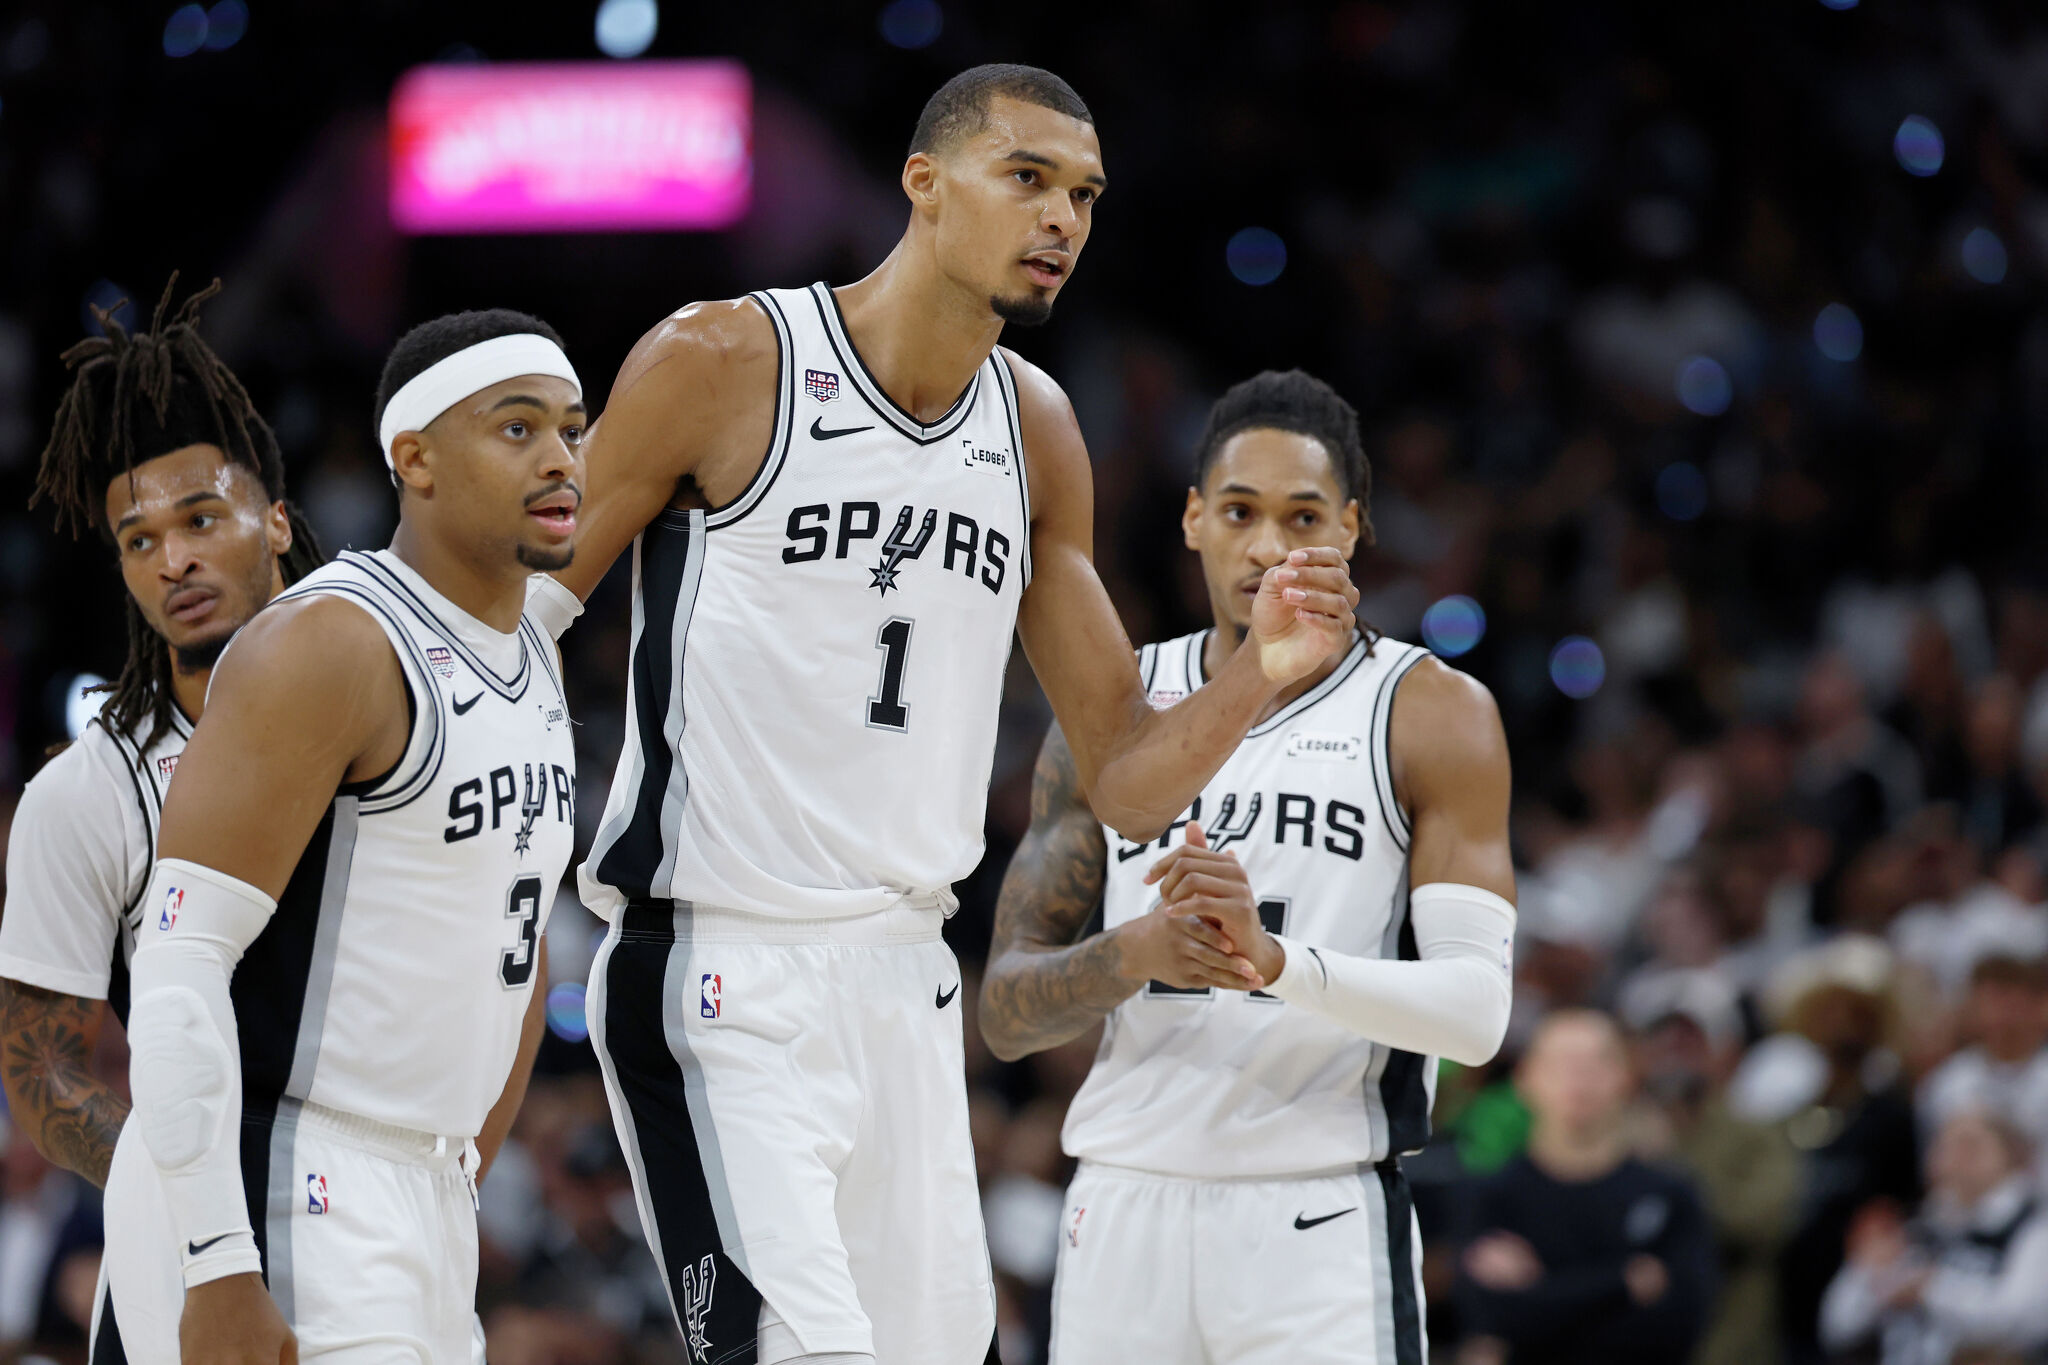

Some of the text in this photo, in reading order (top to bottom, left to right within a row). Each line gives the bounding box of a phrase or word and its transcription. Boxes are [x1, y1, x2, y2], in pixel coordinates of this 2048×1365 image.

[806, 385, 839, 398] 250
[807, 371, 837, 384] USA
[971, 448, 1006, 467] LEDGER
[781, 501, 1010, 598] SPURS
[865, 615, 915, 734] 1
[444, 763, 575, 860] SPUR
[498, 872, 544, 991] 3
